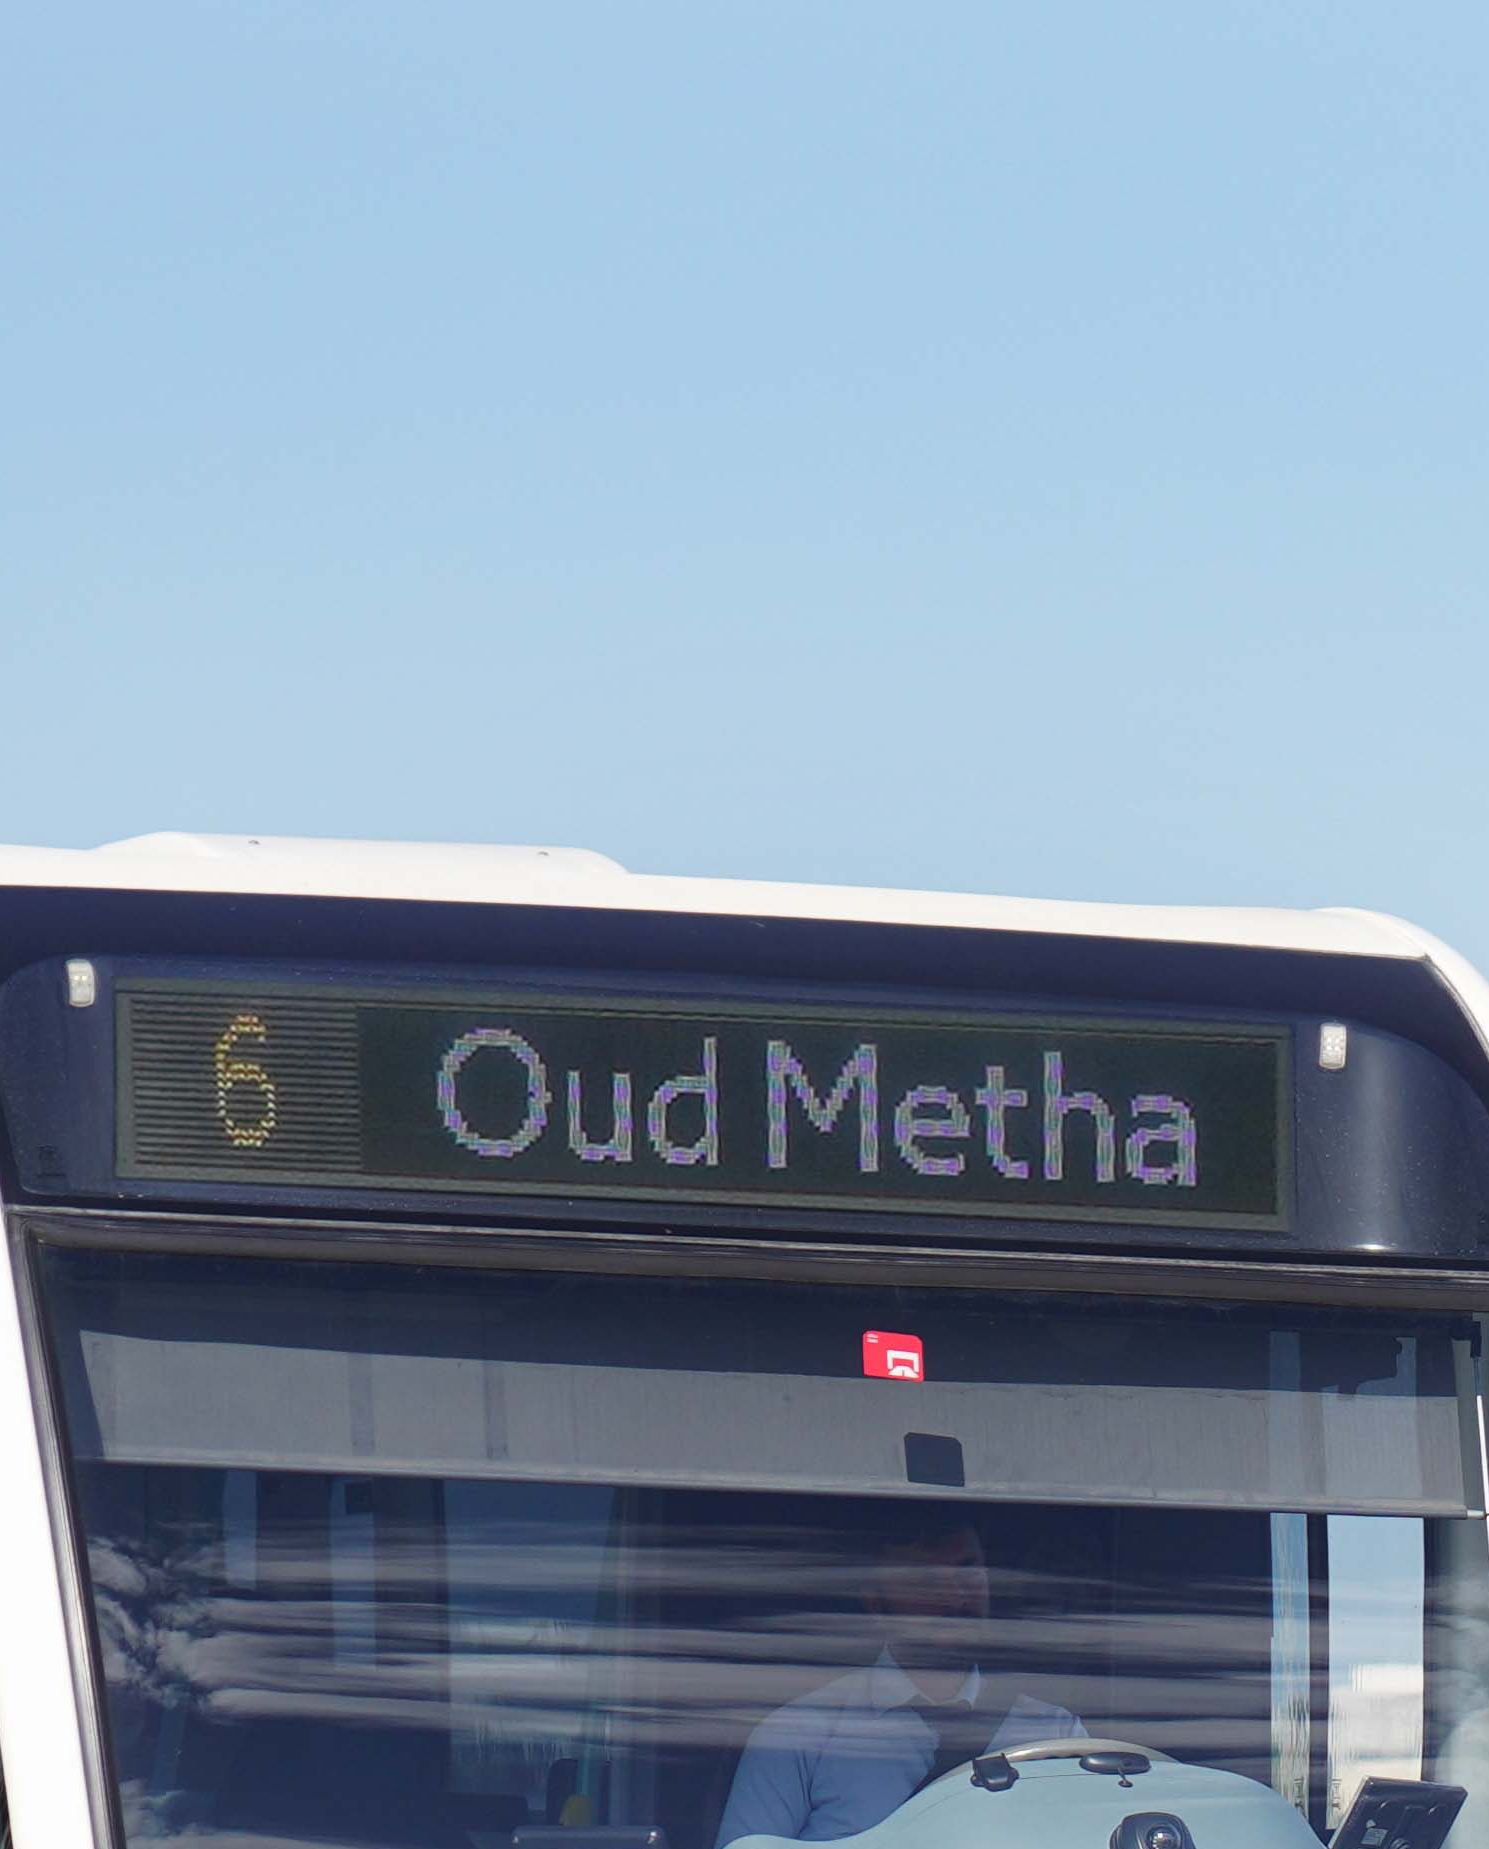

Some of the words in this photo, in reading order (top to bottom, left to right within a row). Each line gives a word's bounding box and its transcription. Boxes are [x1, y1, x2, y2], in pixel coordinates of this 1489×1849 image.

[213, 1012, 278, 1148] 6
[436, 1026, 719, 1168] Oud
[766, 1037, 1199, 1187] Metha
